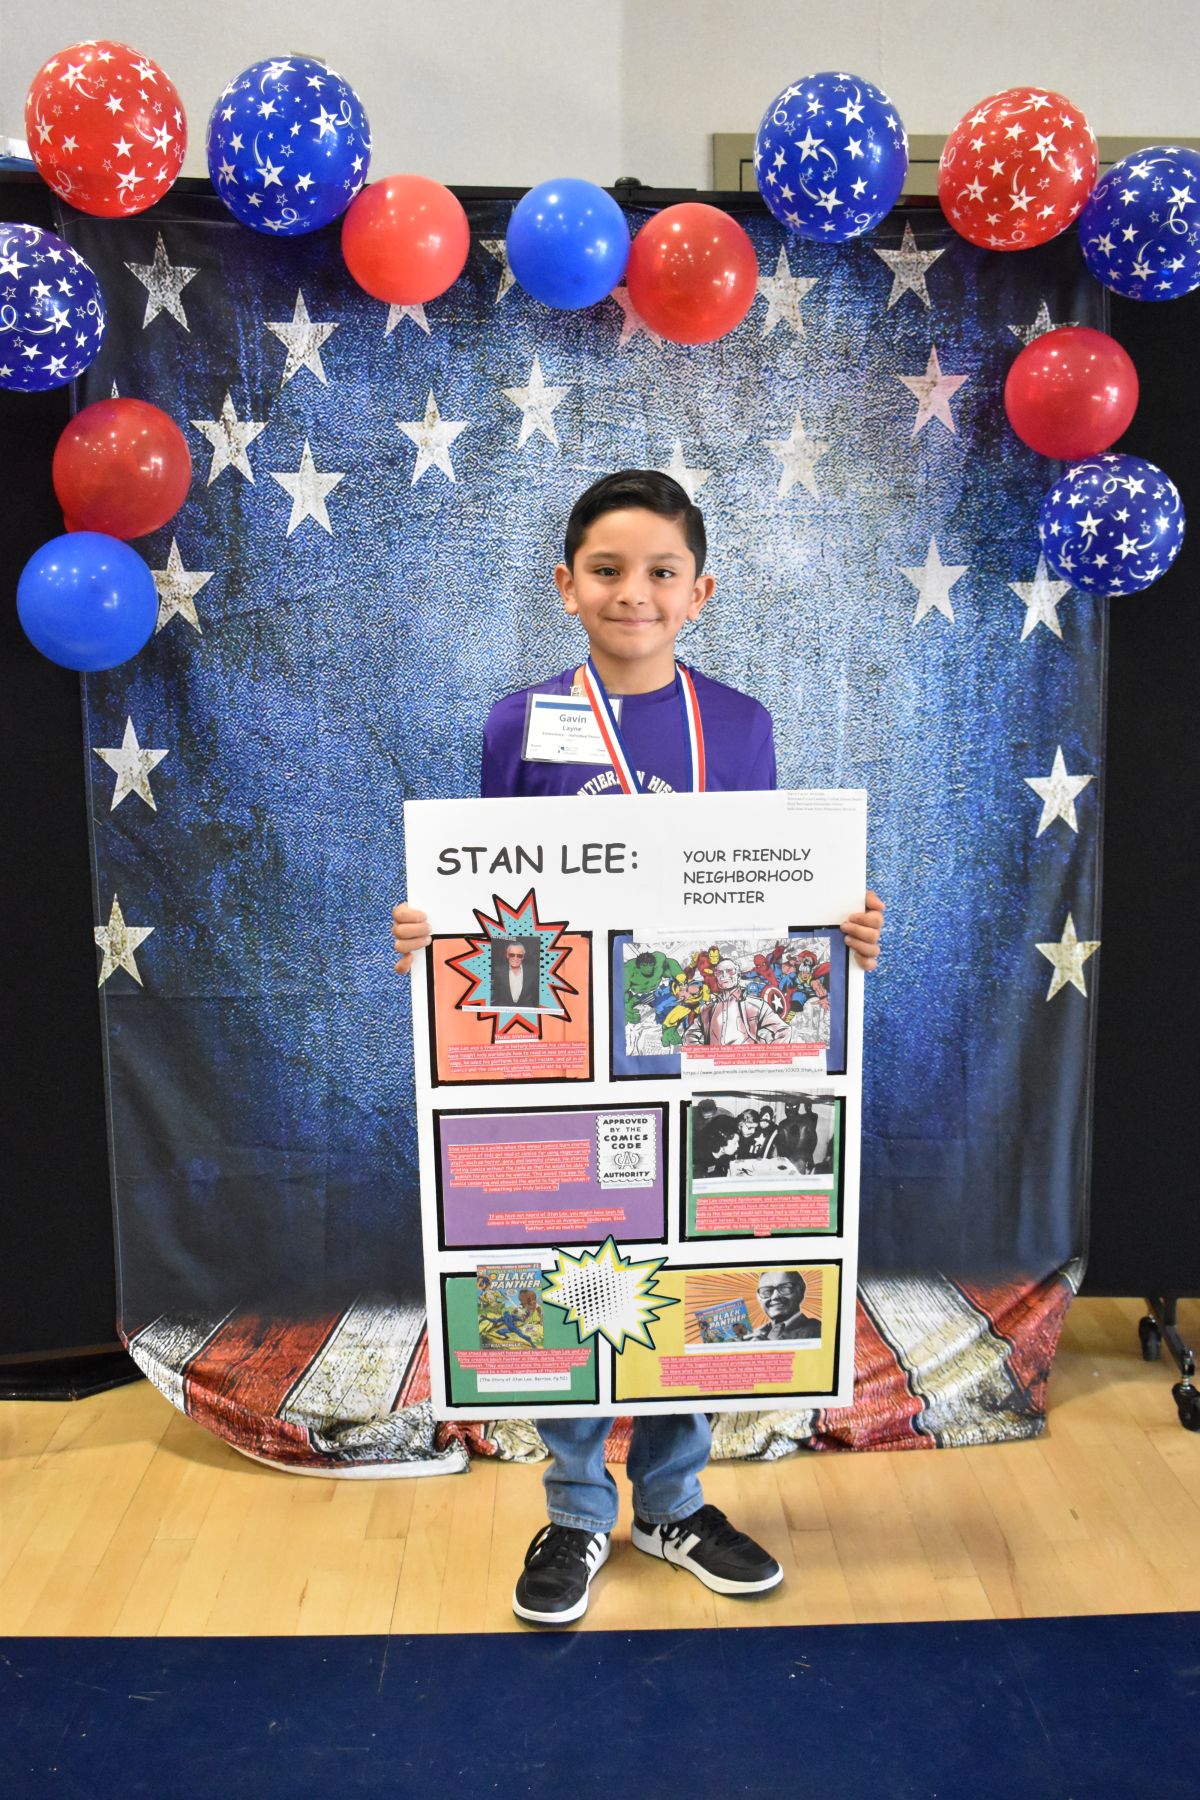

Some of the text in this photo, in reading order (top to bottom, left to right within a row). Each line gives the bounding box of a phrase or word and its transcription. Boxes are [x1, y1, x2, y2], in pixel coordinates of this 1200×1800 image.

[559, 713, 587, 723] Gavin
[436, 843, 638, 875] STAN LEE:
[683, 848, 811, 863] YOUR FRIENDLY
[683, 869, 814, 884] NEIGHBORHOOD
[683, 891, 765, 905] FRONTIER
[497, 1271, 535, 1281] BLACK
[490, 1280, 541, 1289] PANTHER
[709, 1314, 746, 1329] PANTHER
[713, 1310, 740, 1321] BLACK
